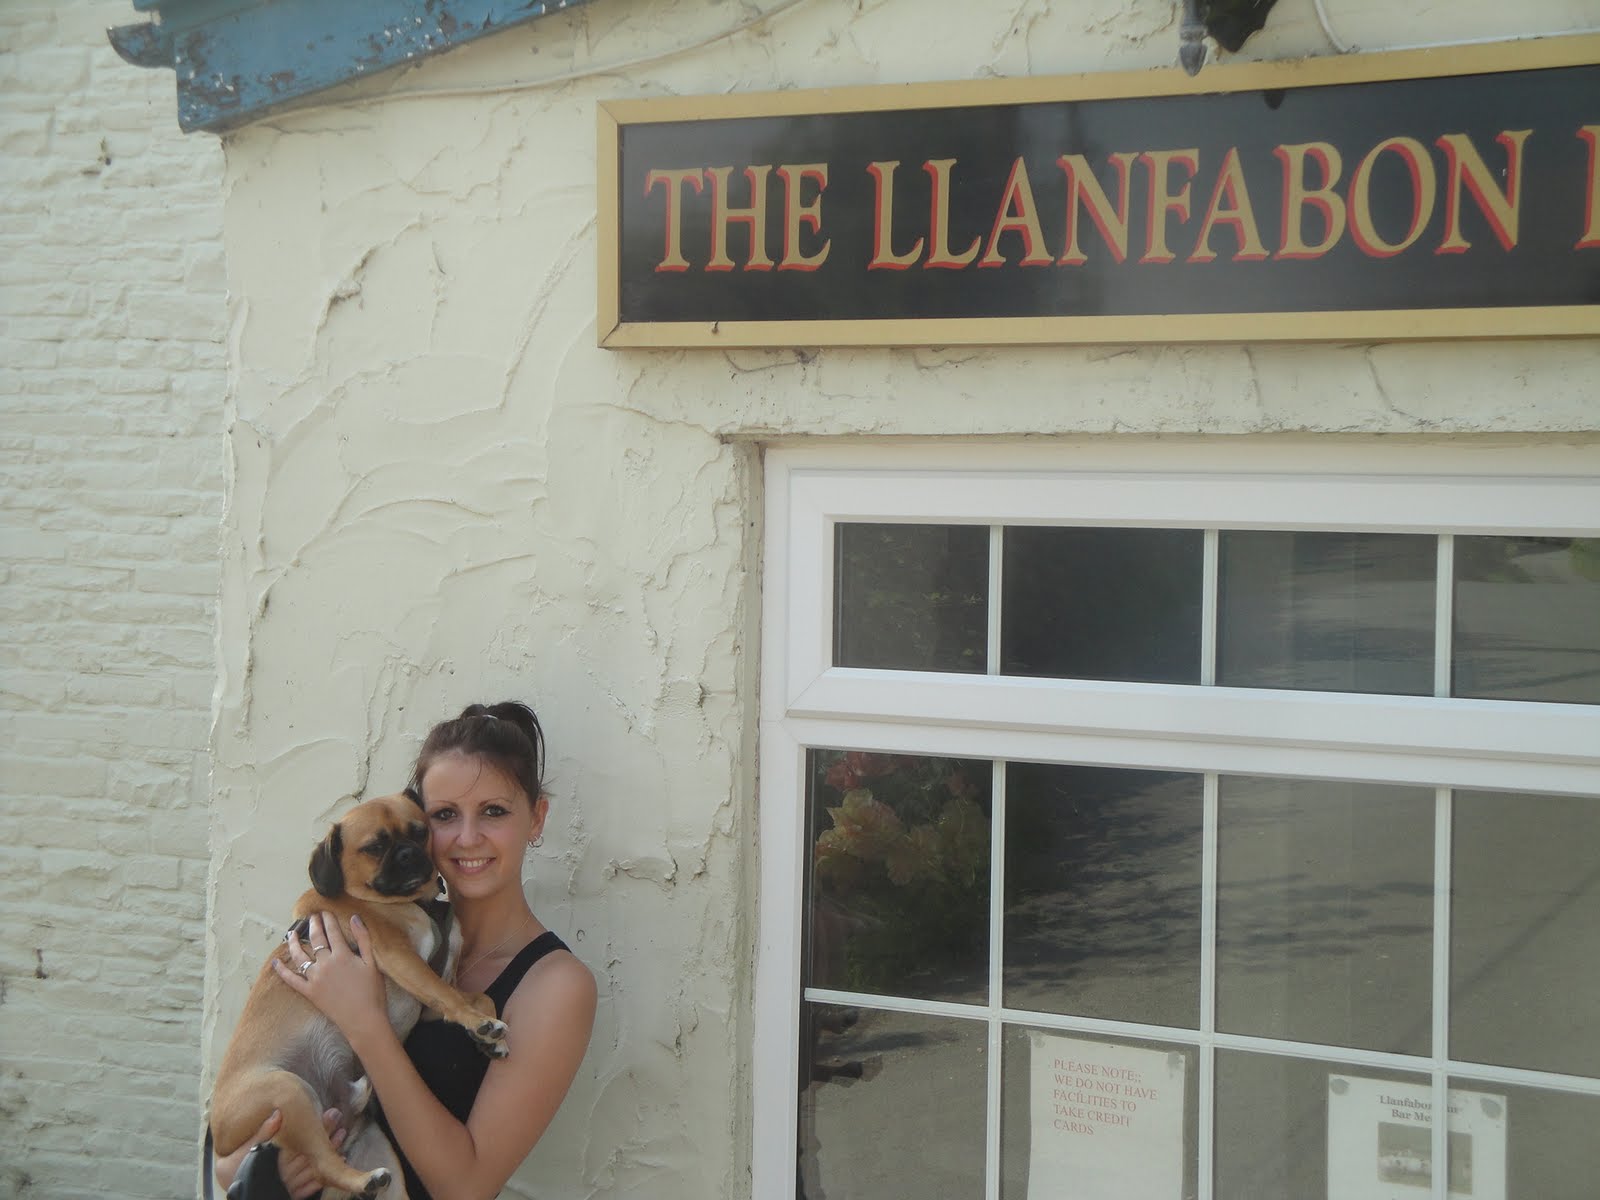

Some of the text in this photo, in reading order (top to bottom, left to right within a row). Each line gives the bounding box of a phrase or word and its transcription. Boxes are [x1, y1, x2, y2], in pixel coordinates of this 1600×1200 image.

[644, 163, 831, 272] THE
[866, 129, 1533, 271] LLANFABON
[1054, 1058, 1099, 1075] PLEASE
[1054, 1073, 1158, 1100] WE DO NOT HAVE
[1053, 1089, 1137, 1112] FACILITIES TO
[1053, 1104, 1132, 1128] TAKE CREDIT
[1391, 1109, 1412, 1119] Bar
[1053, 1119, 1095, 1135] CARDS
